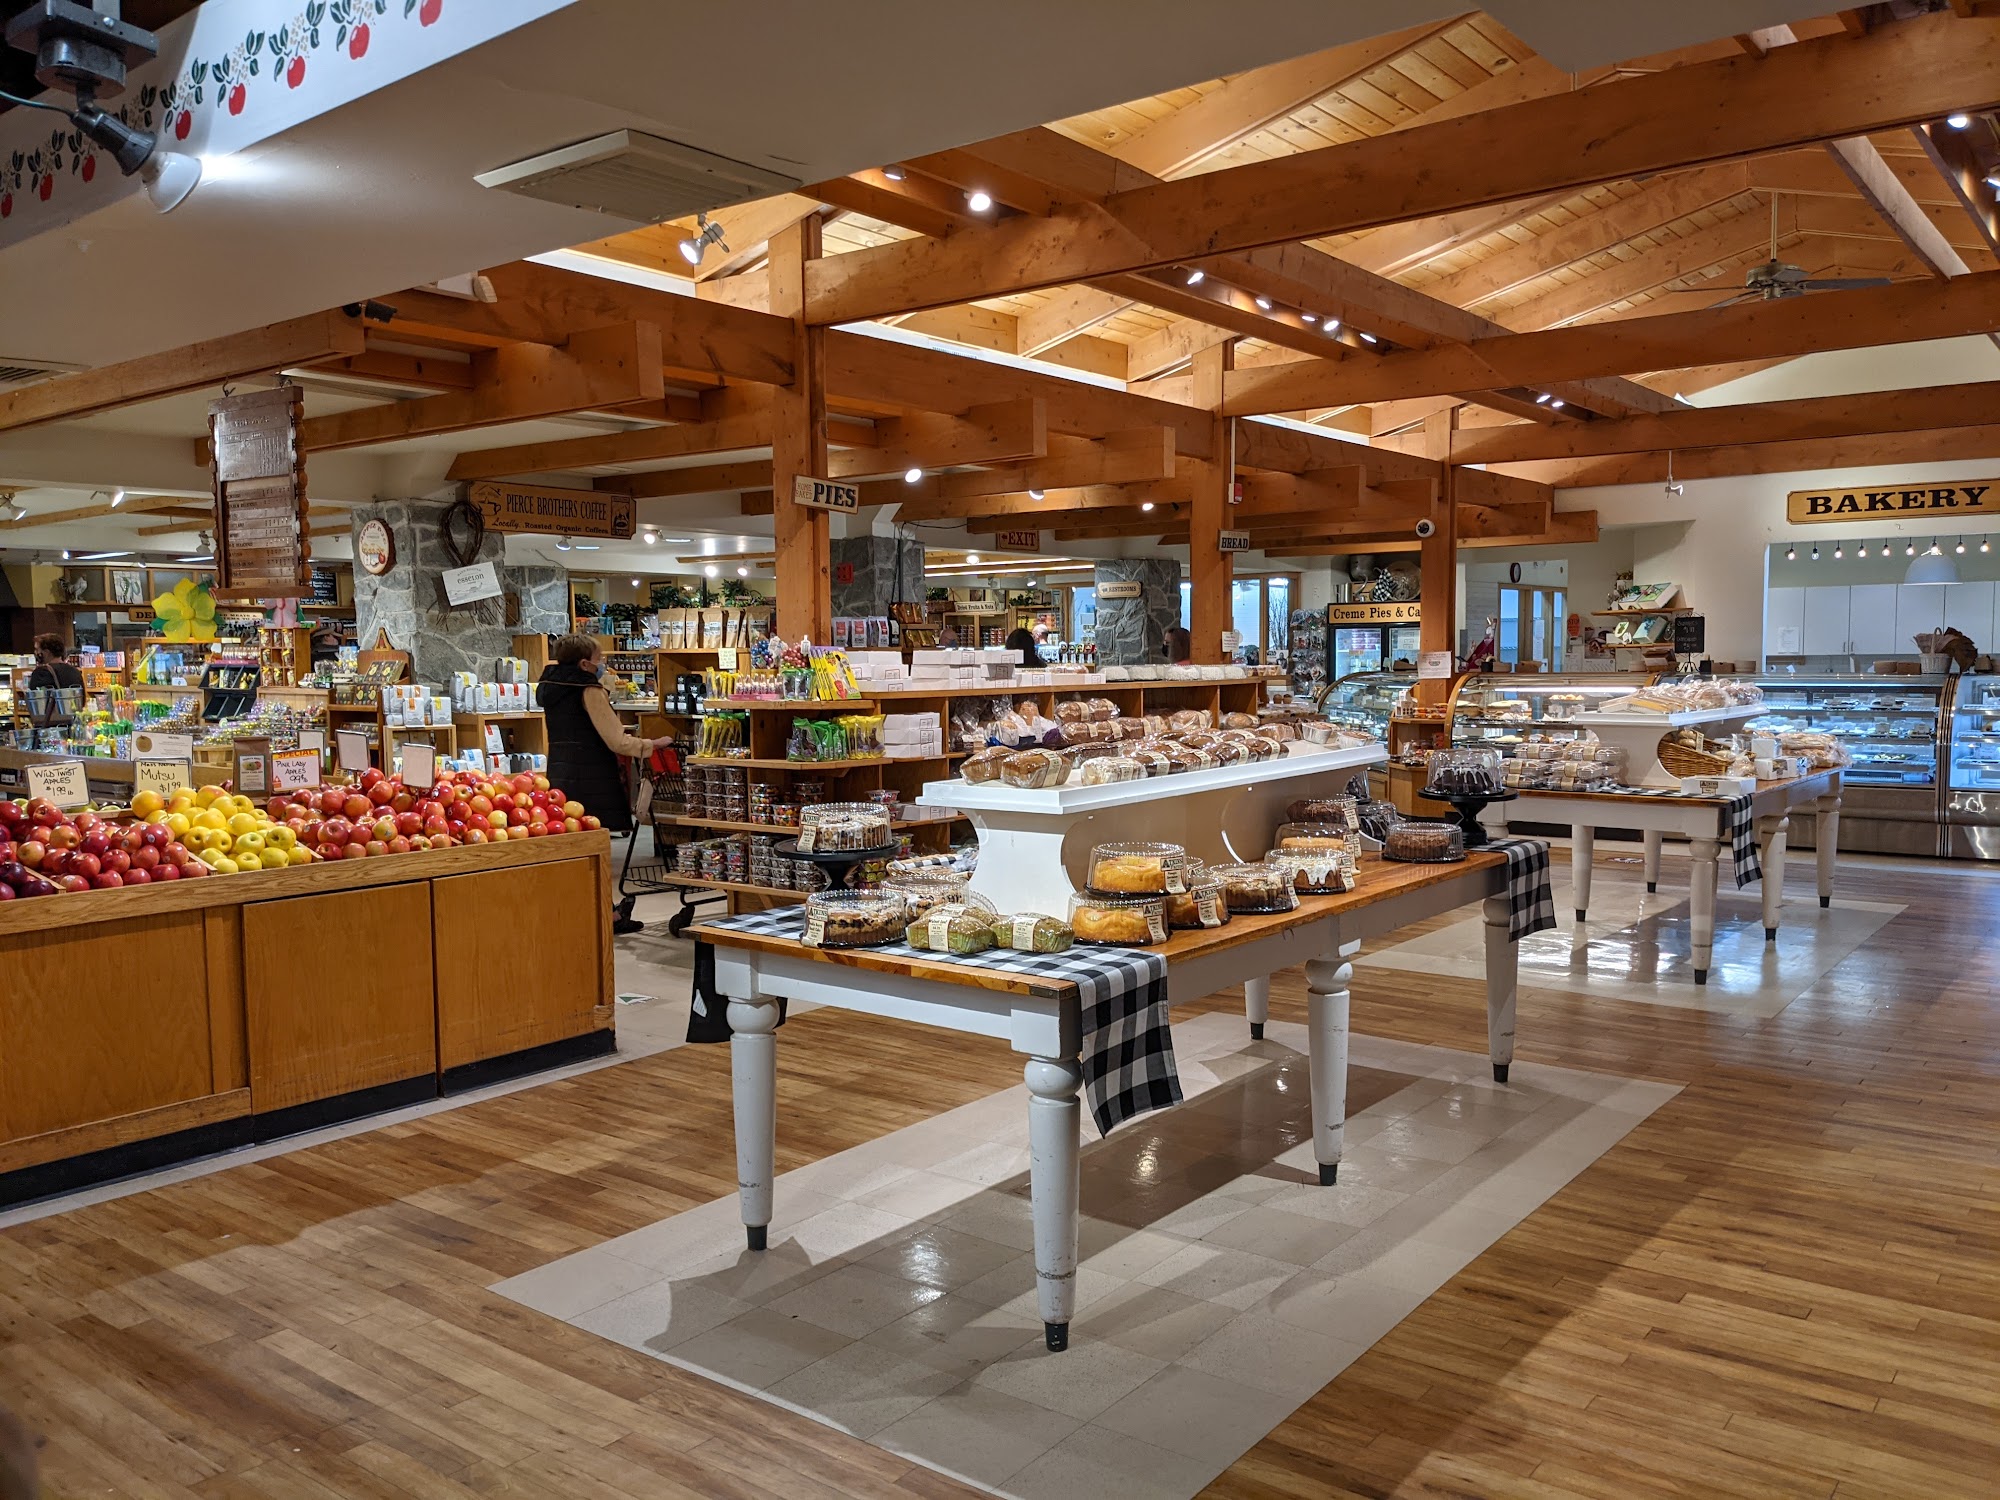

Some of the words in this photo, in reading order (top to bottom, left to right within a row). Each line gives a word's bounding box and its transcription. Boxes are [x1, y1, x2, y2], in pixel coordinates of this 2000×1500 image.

[812, 482, 857, 508] PIES
[1805, 486, 1990, 515] BAKERY
[506, 494, 534, 515] PIERCE
[537, 497, 578, 519] BROTHERS
[580, 501, 607, 521] COFFEE
[524, 522, 552, 530] Roasted
[556, 524, 582, 533] Organic
[585, 526, 609, 534] Coffees
[1007, 531, 1036, 546] EXIT
[1221, 537, 1249, 549] BREAD
[1333, 608, 1365, 620] Creme
[1369, 607, 1392, 619] Pies
[1395, 606, 1404, 618] &
[1407, 606, 1421, 617] Ca
[43, 776, 71, 785] APPLES
